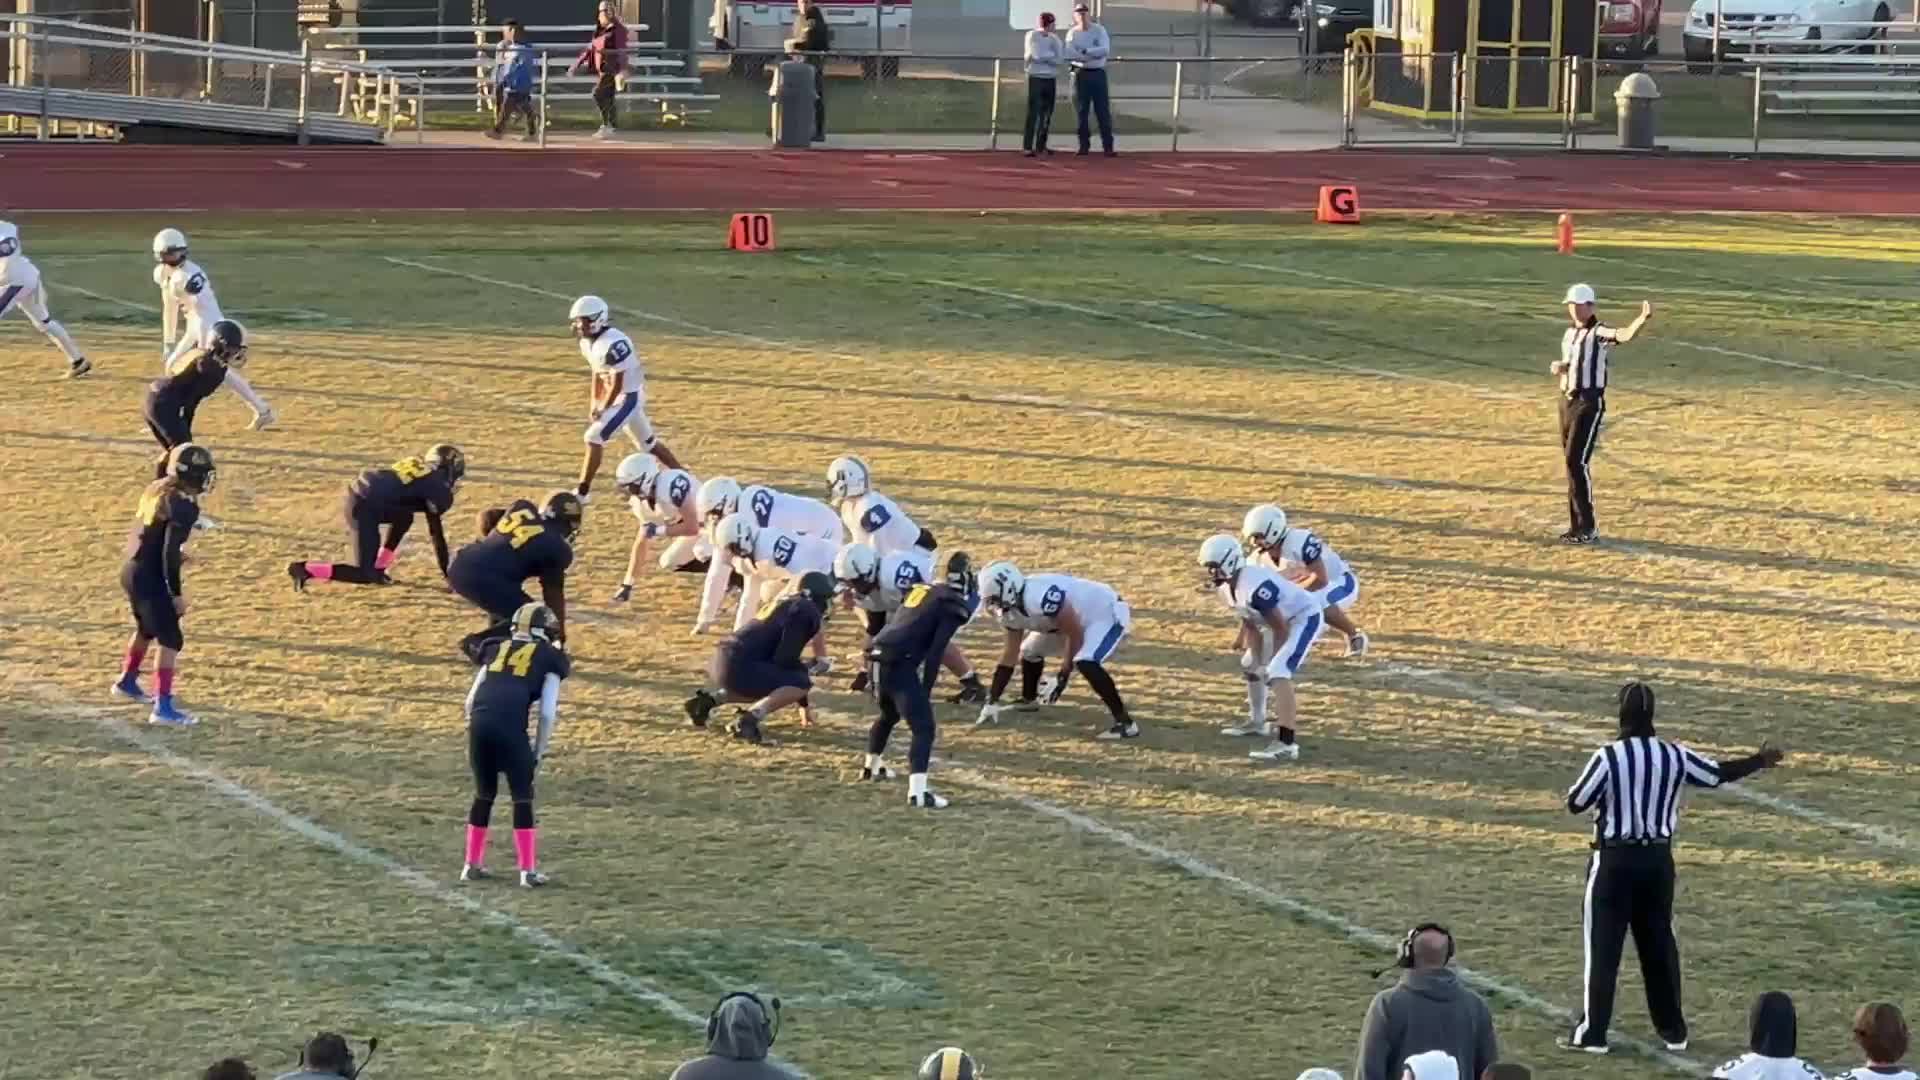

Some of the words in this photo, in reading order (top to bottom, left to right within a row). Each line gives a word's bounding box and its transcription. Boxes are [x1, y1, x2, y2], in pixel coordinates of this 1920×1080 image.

[1331, 188, 1354, 214] G
[740, 215, 768, 246] 10
[754, 491, 774, 516] 22
[496, 508, 545, 549] 54
[773, 538, 793, 562] 50
[1257, 587, 1273, 601] 8
[488, 639, 538, 678] 14
